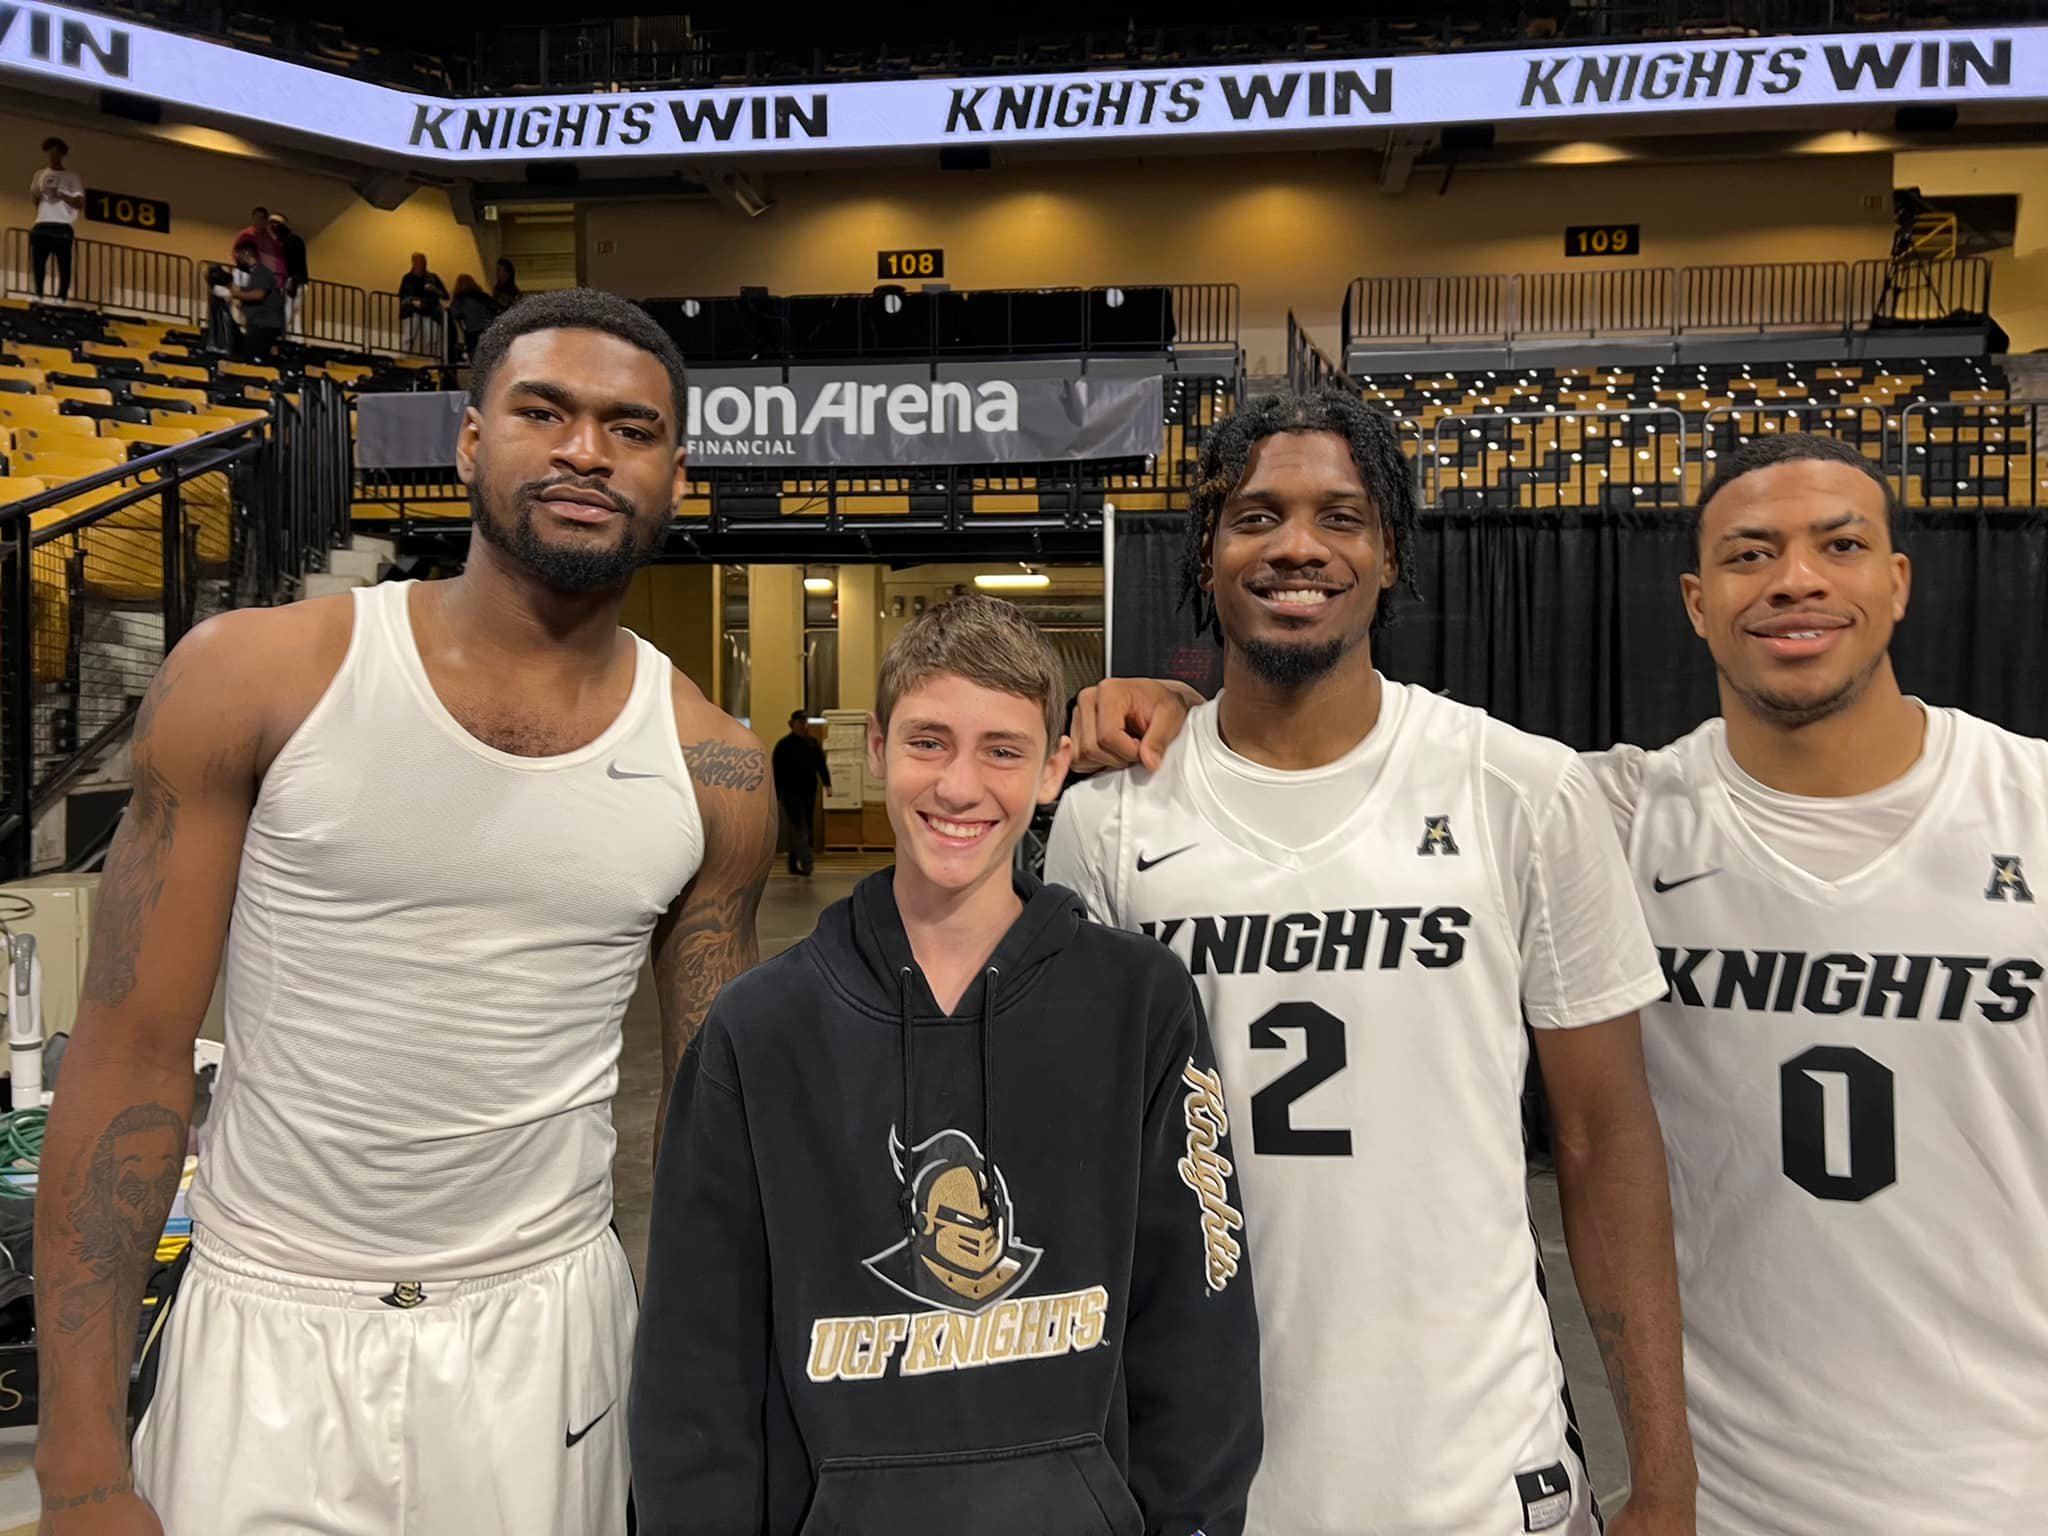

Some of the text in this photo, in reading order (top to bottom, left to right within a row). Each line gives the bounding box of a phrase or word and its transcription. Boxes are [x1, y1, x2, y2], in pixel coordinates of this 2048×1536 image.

[945, 67, 1393, 132] KNIGHTS WIN
[1518, 37, 2012, 106] KNIGHTS WIN
[408, 93, 828, 150] KNIGHTS WIN
[97, 196, 156, 226] 108
[1577, 229, 1628, 253] 109
[887, 253, 934, 275] 108
[800, 379, 1019, 435] Arena
[686, 439, 797, 456] FINANCIAL
[1655, 945, 2044, 1023] KNIGHTS
[1249, 1001, 1353, 1156] 2
[1780, 1044, 1898, 1201] 0
[1178, 1055, 1243, 1293] Knights
[806, 1284, 1109, 1383] UCF KNIGHTS
[1537, 1473, 1556, 1495] L
